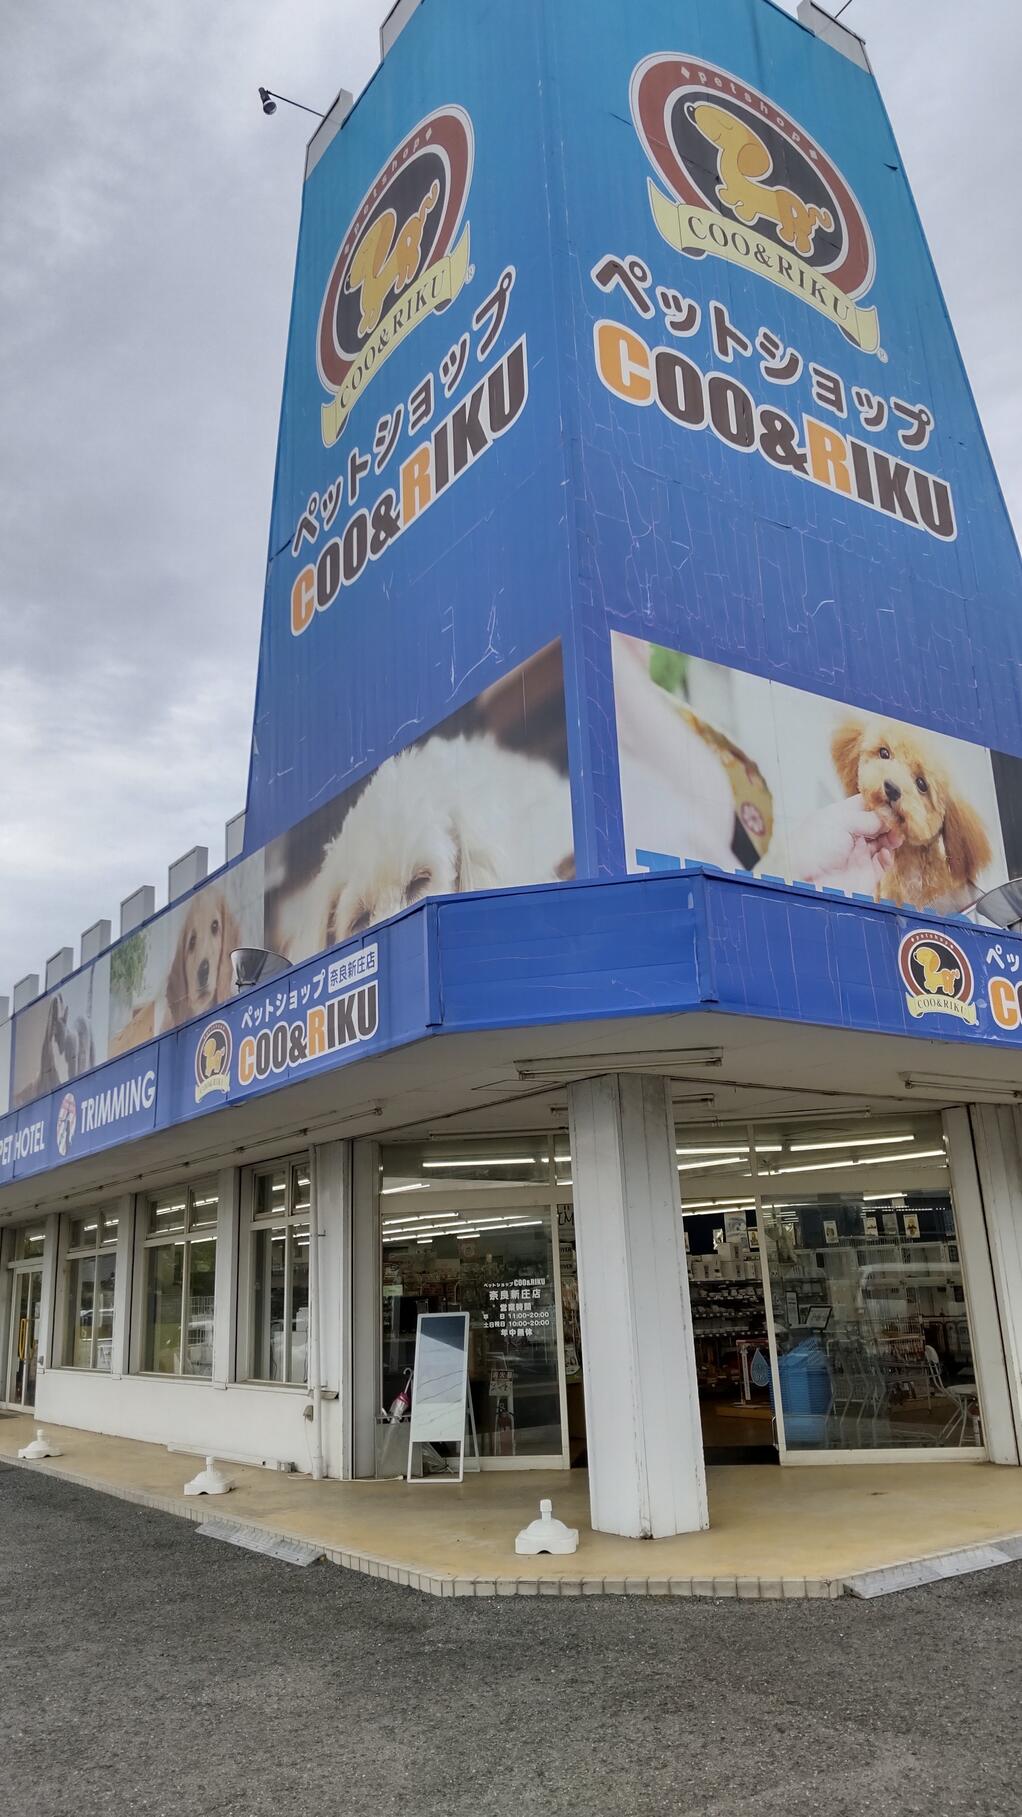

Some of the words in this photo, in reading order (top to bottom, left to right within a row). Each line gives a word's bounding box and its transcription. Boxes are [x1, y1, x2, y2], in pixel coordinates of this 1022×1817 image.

[698, 71, 800, 142] petshop
[353, 136, 421, 236] petshop
[688, 215, 850, 321] COO&RIKU
[340, 269, 446, 410] COO&RIKU
[592, 254, 934, 451] ペットショップ
[293, 266, 516, 556] ペットショップ
[594, 320, 957, 541] COO&RIKU
[291, 335, 527, 634] COO&RIKU
[241, 969, 325, 1029] ペットショップ
[330, 951, 376, 987] 奈良新庄店
[988, 976, 1022, 1030] C
[239, 981, 378, 1085] COO&RIKU
[14, 1120, 45, 1161] HOTEL
[81, 1070, 156, 1134] TRIMMING
[489, 1289, 541, 1301] 奈良新庄店
